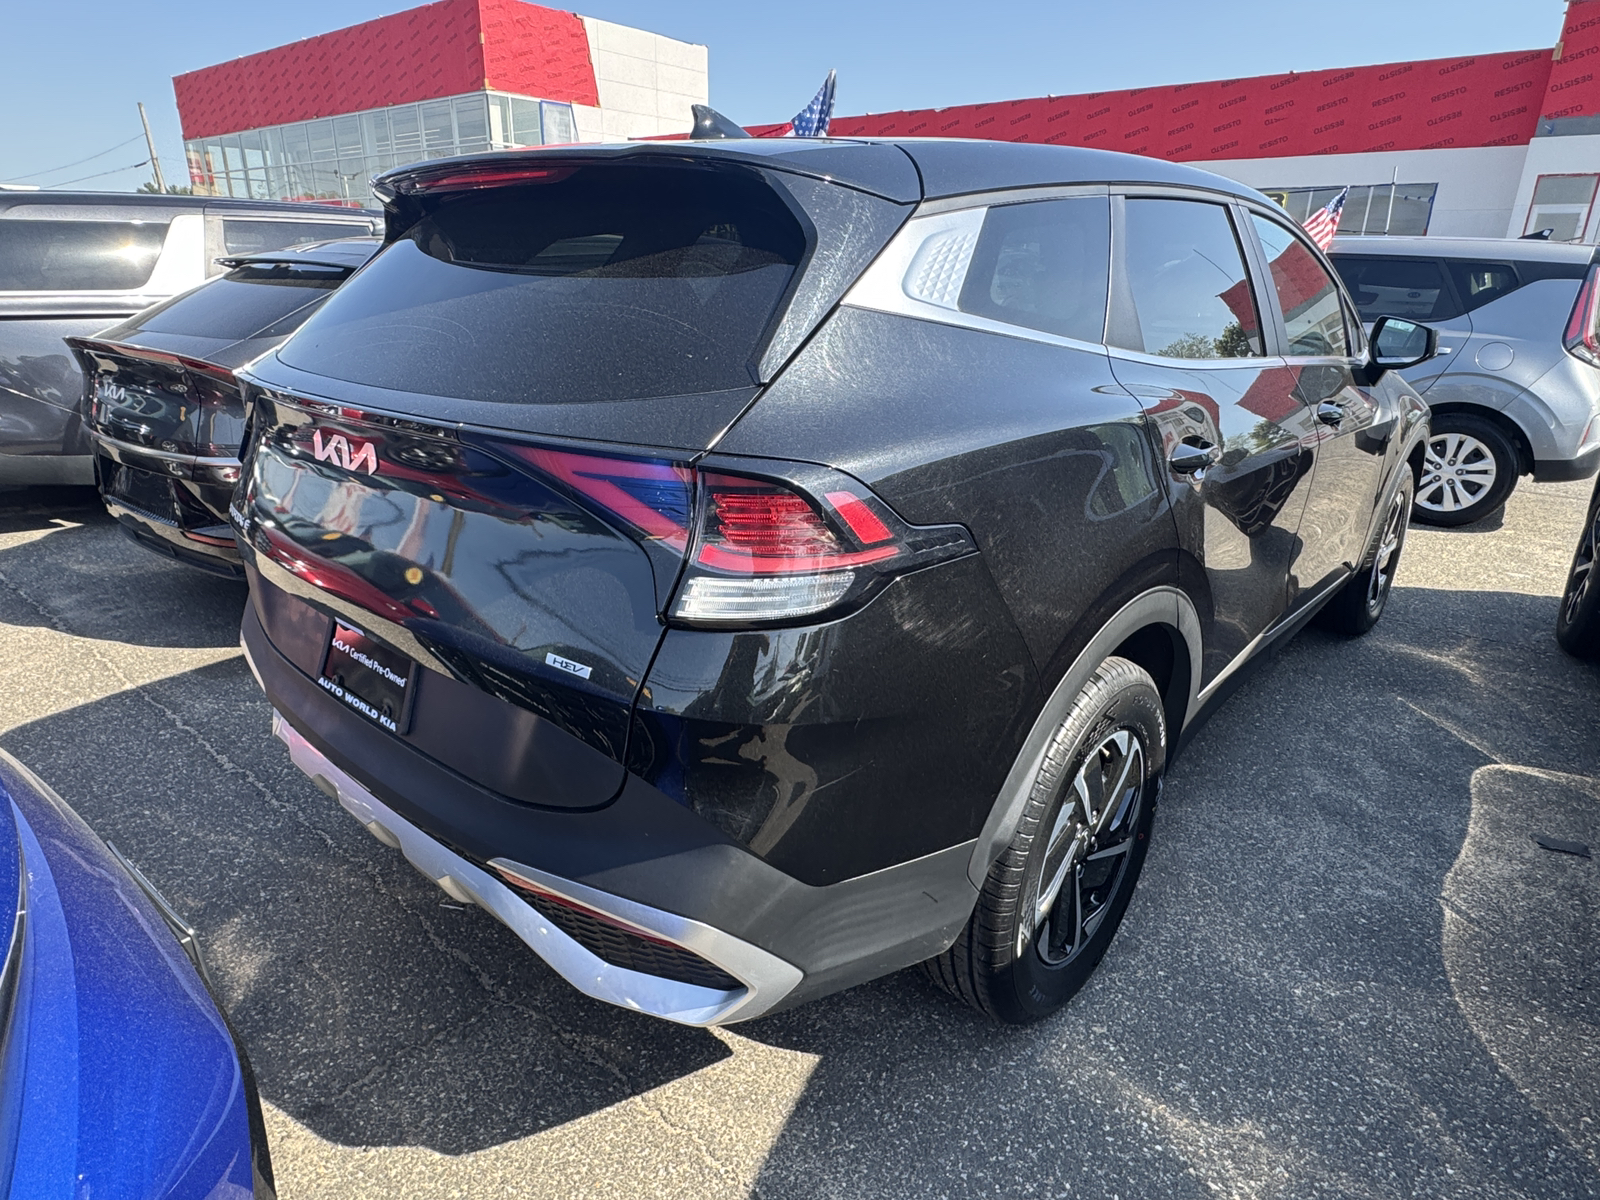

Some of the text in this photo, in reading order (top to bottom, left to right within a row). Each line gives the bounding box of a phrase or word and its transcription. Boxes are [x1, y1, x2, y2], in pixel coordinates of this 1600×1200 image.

[1502, 52, 1542, 70] RESISTO
[1556, 46, 1599, 66] RESISTO
[1378, 64, 1413, 81] RESISTO
[1438, 57, 1475, 75] RESISTO
[1270, 75, 1300, 91] RESISTO
[1322, 71, 1355, 87] RESISTO
[1551, 73, 1593, 92] RESISTO
[1431, 86, 1467, 103] RESISTO
[1494, 81, 1532, 98] RESISTO
[1172, 100, 1199, 114] RESISTO
[1218, 95, 1247, 110] RESISTO
[1316, 97, 1349, 113] RESISTO
[1371, 91, 1406, 107] RESISTO
[1128, 103, 1154, 118] RESISTO
[1265, 100, 1295, 115] RESISTO
[1489, 106, 1528, 122] RESISTO
[1213, 119, 1242, 133] RESISTO
[1367, 115, 1402, 131] RESISTO
[1426, 110, 1462, 127] RESISTO
[1125, 126, 1150, 140] RESISTO
[1168, 122, 1194, 137] RESISTO
[1313, 119, 1345, 135] RESISTO
[1166, 143, 1192, 157] RESISTO
[1211, 140, 1239, 154] RESISTO
[1259, 135, 1289, 150] RESISTO
[104, 384, 126, 400] KIA
[313, 429, 377, 476] KIA
[349, 648, 374, 669] Certified
[372, 661, 406, 688] Pre-Owned
[552, 657, 585, 673] HEV
[318, 677, 397, 732] AUTO WORLD KIA
